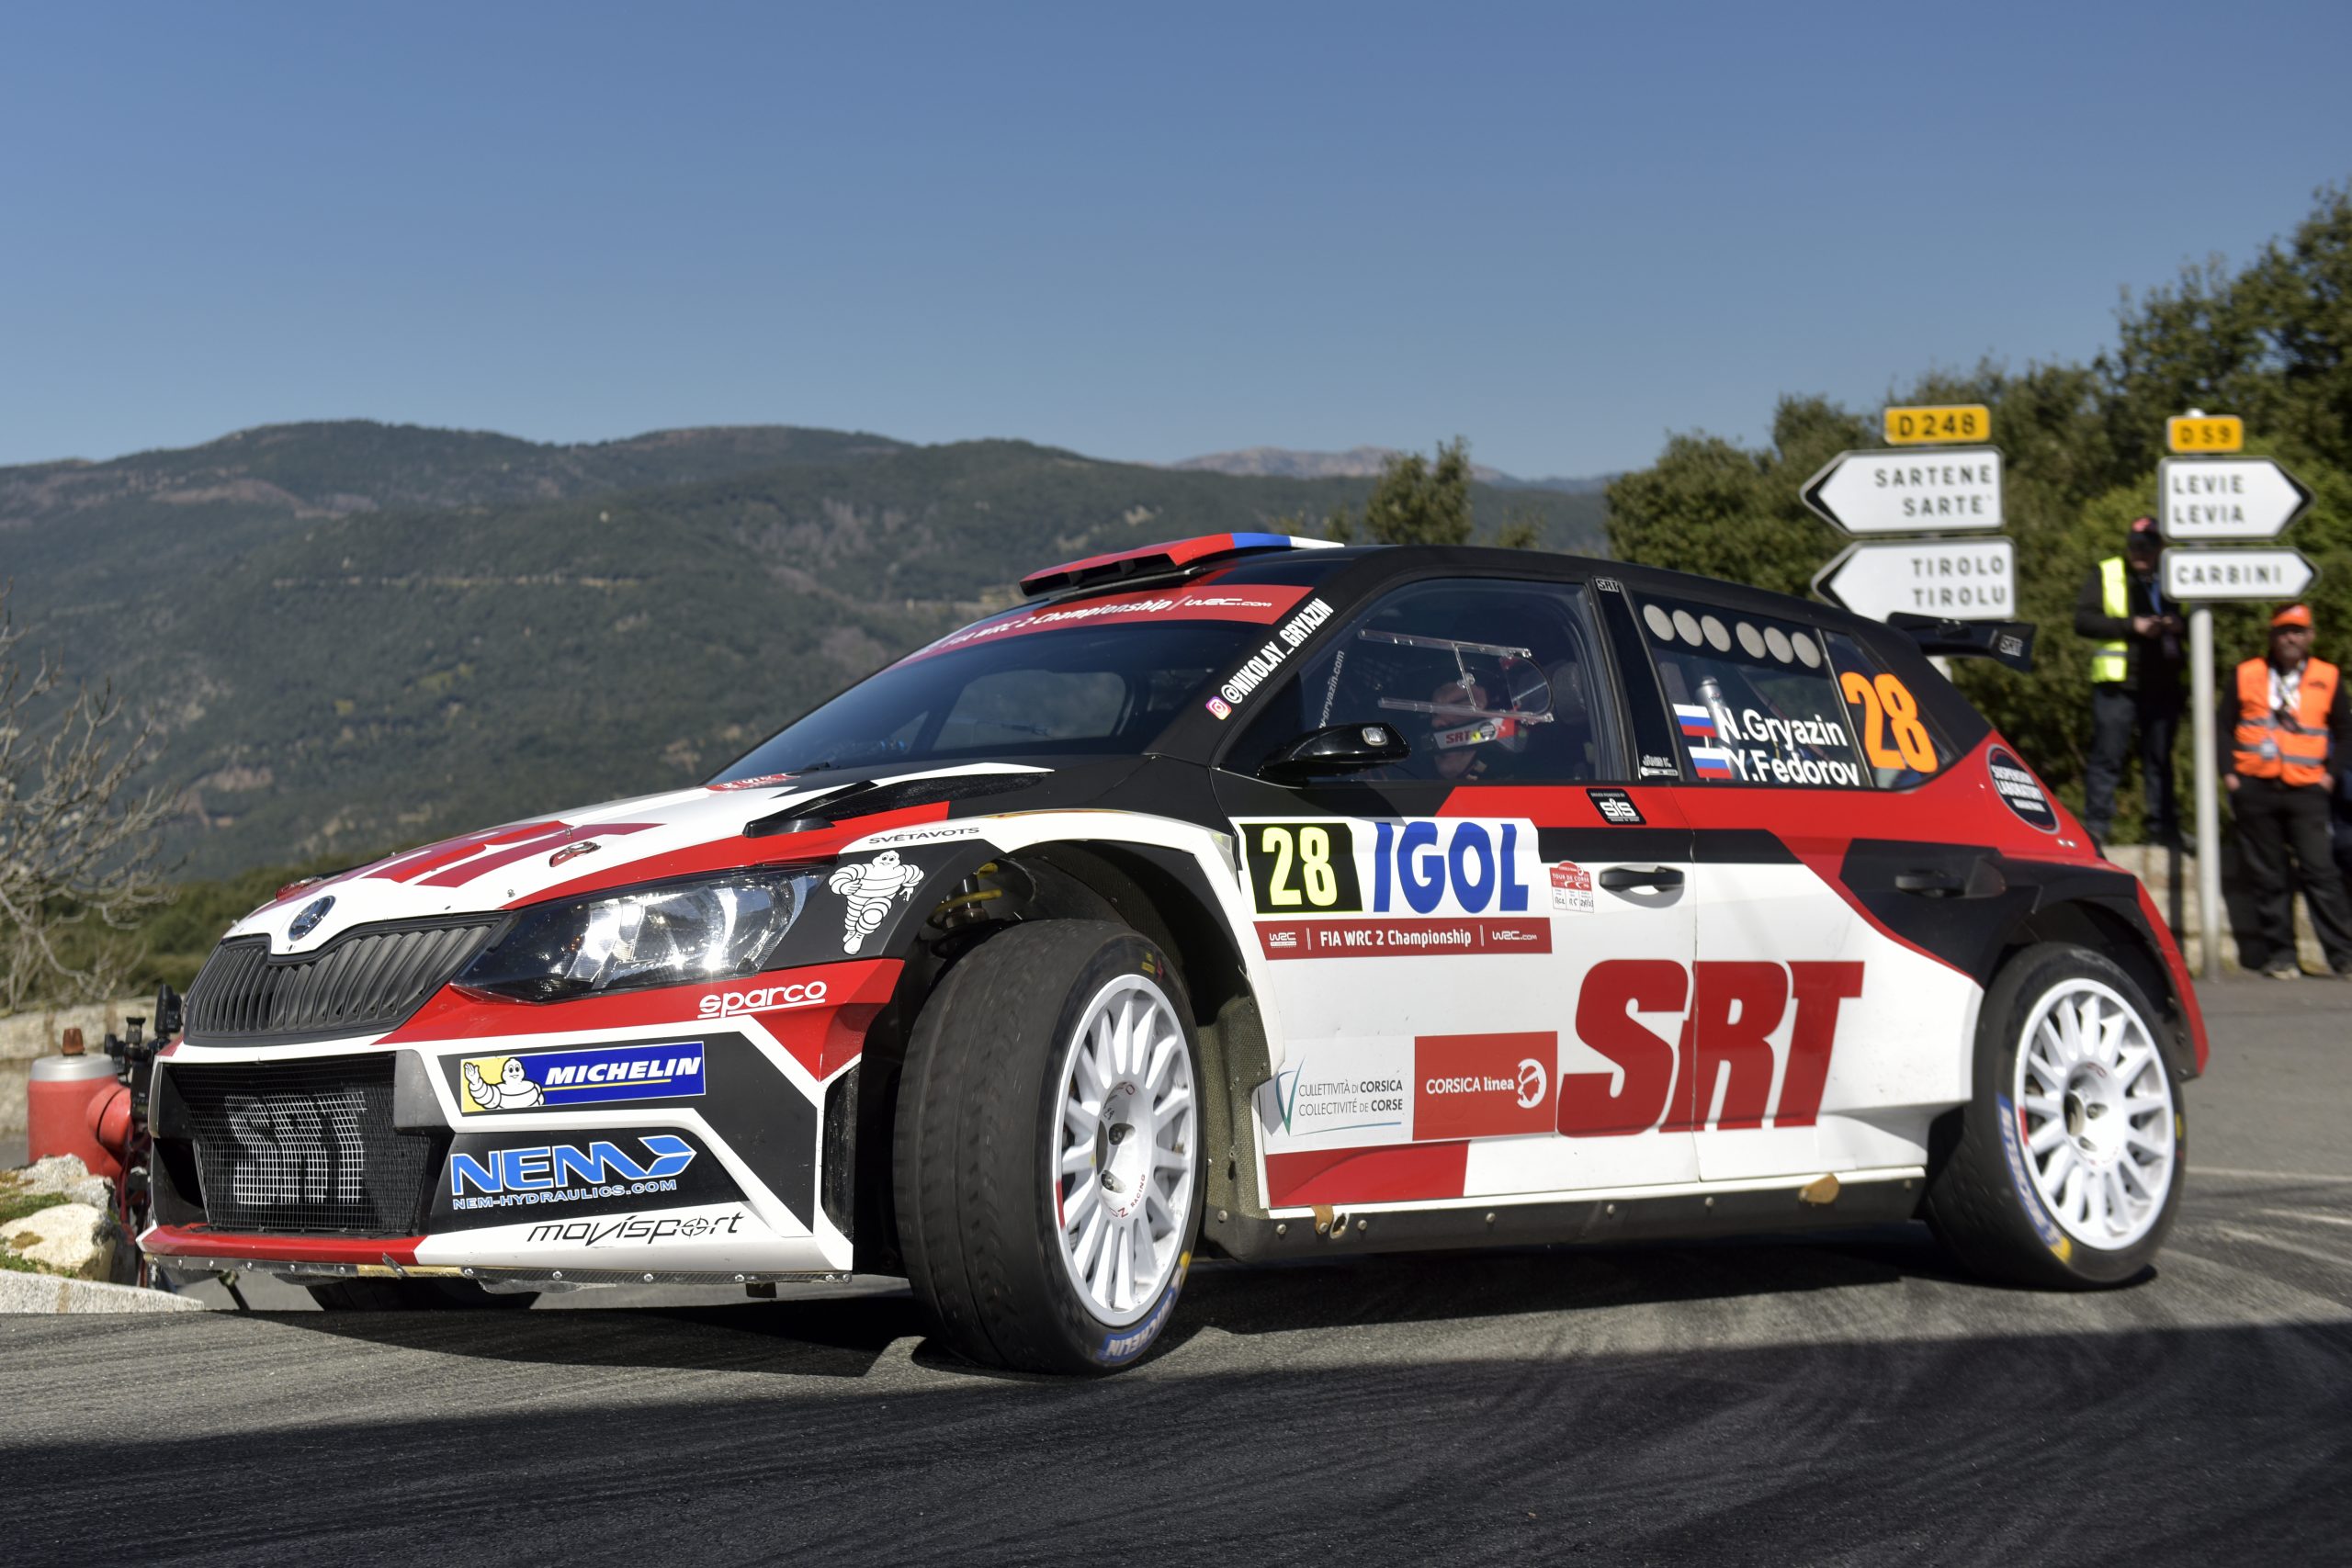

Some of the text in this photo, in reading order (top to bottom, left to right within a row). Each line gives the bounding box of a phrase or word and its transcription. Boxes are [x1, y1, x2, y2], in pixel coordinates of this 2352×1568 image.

[1898, 413, 1975, 436] D 248
[2180, 425, 2232, 445] D 59
[1874, 464, 1992, 488] SARTENE
[2173, 474, 2245, 495] LEVIE
[2173, 504, 2245, 525] LEVIA
[1911, 555, 2004, 579] TIROLO
[2176, 565, 2282, 585] CARBINI
[1912, 585, 2007, 607] TIROLU
[1034, 598, 1173, 625] Championship
[1714, 705, 1849, 750] N.Gryazin
[1839, 671, 1938, 773] 28
[1724, 749, 1860, 786] Y.Fedorov
[1262, 821, 1529, 914] 28 IGOL
[1320, 931, 1341, 947] FIA
[1344, 931, 1373, 946] WRC
[1376, 931, 1385, 945] 2
[1387, 929, 1471, 948] Championship
[698, 981, 827, 1018] sparco
[1557, 959, 1864, 1137] SRT
[545, 1056, 702, 1086] MICHELIN
[1299, 1079, 1351, 1097] CULLETTIVITÀ
[1360, 1080, 1403, 1093] CORSICA
[1426, 1077, 1515, 1094] CORSICA linea
[1299, 1099, 1357, 1117] COLLECTIVITÉ
[1371, 1099, 1403, 1111] CORSE
[453, 1179, 677, 1211] NEM-HYDRAULICS.COM
[526, 1212, 744, 1247] movisport
